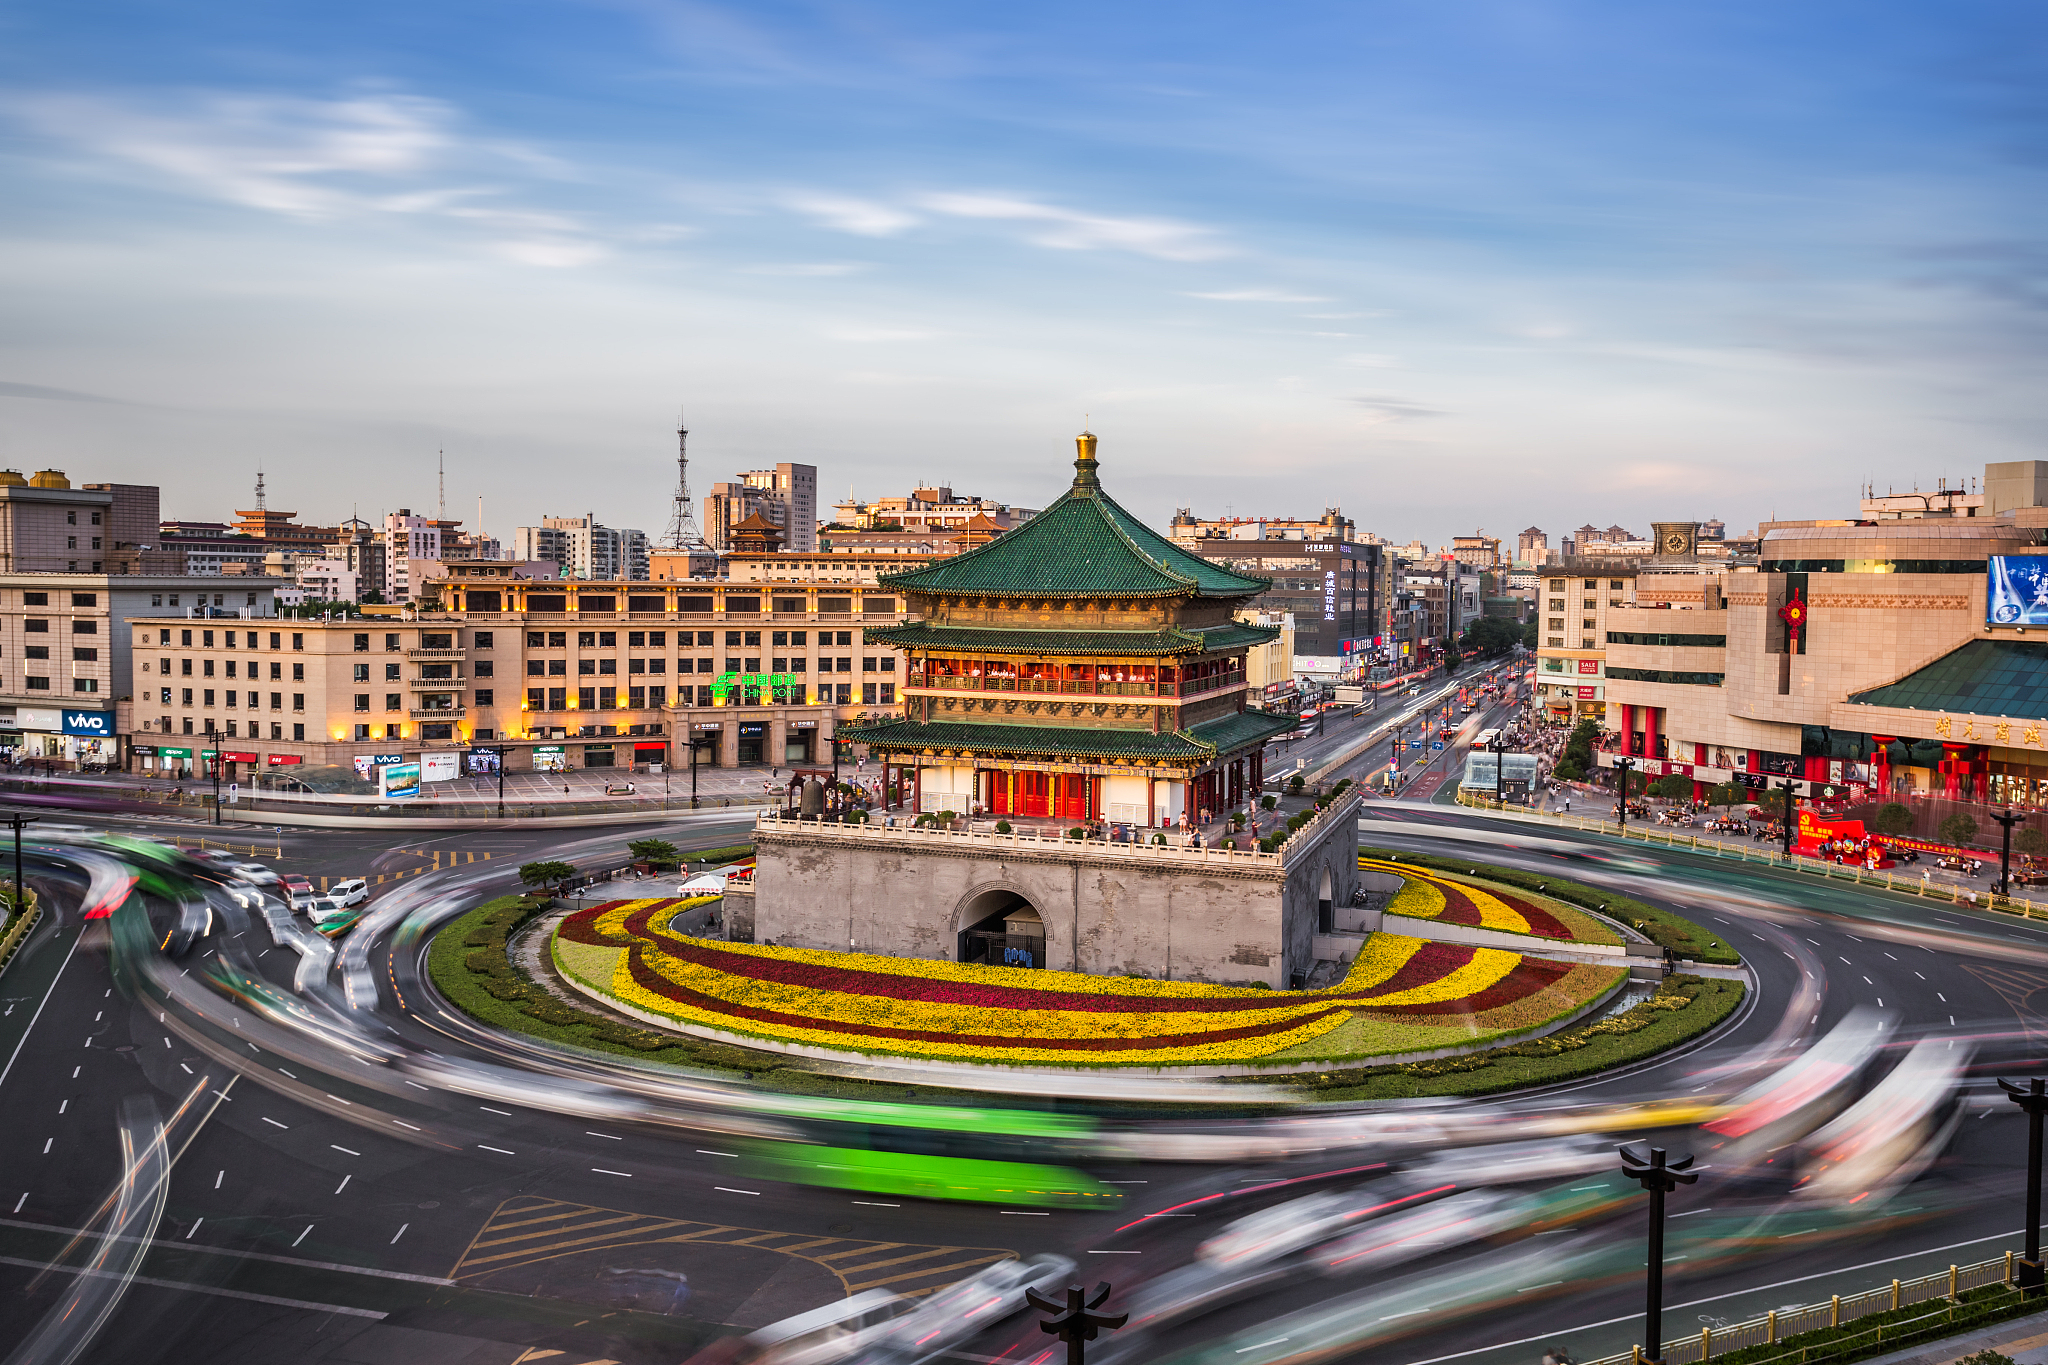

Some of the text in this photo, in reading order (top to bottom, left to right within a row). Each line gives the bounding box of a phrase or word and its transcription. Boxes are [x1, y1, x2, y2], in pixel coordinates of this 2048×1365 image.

[741, 673, 796, 687] 中国邮政
[741, 688, 796, 698] CHINA POST
[68, 713, 103, 728] vivo
